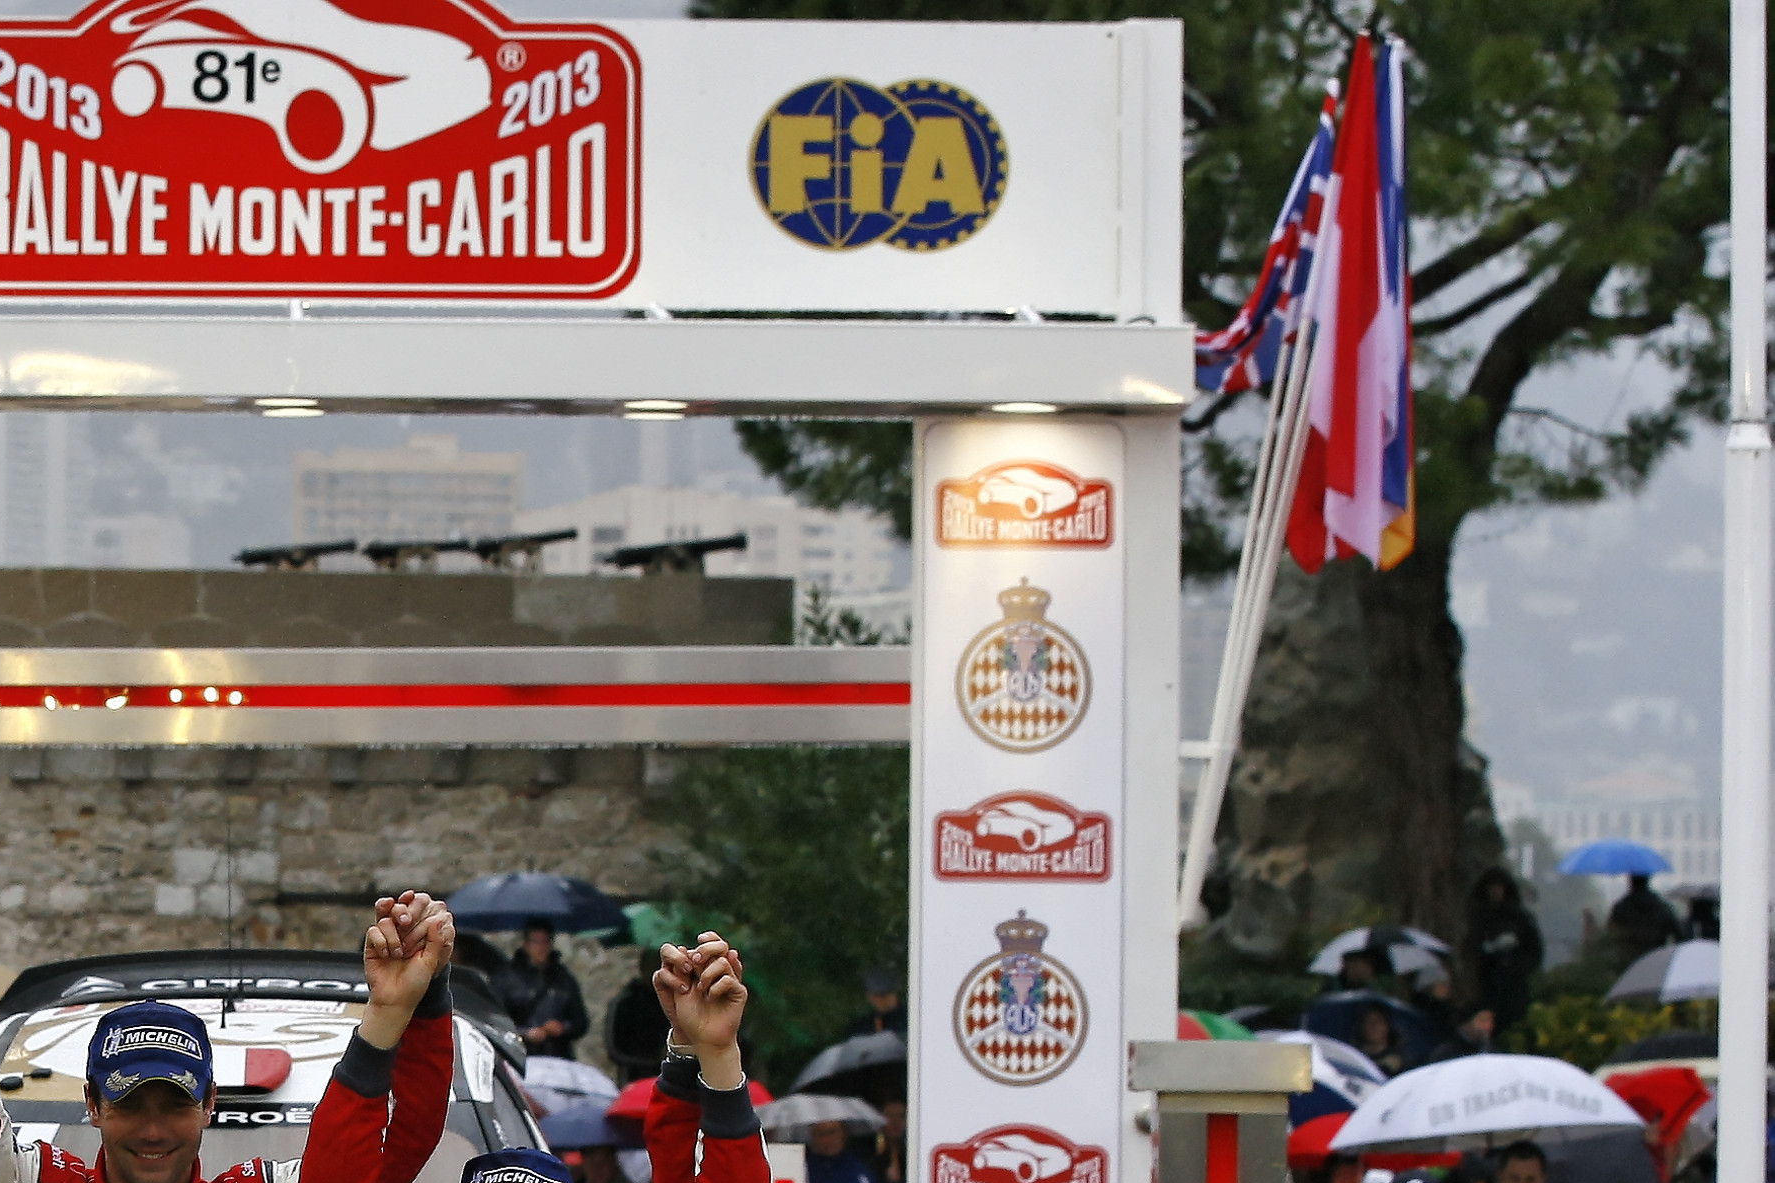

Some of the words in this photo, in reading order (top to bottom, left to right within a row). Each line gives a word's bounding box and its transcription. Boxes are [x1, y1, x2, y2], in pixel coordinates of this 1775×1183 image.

[498, 49, 600, 139] 2013
[188, 122, 606, 258] MONTE-CARLO
[942, 835, 992, 872] RALLYE
[141, 976, 370, 991] CITRO
[125, 1032, 196, 1052] MICHELIN
